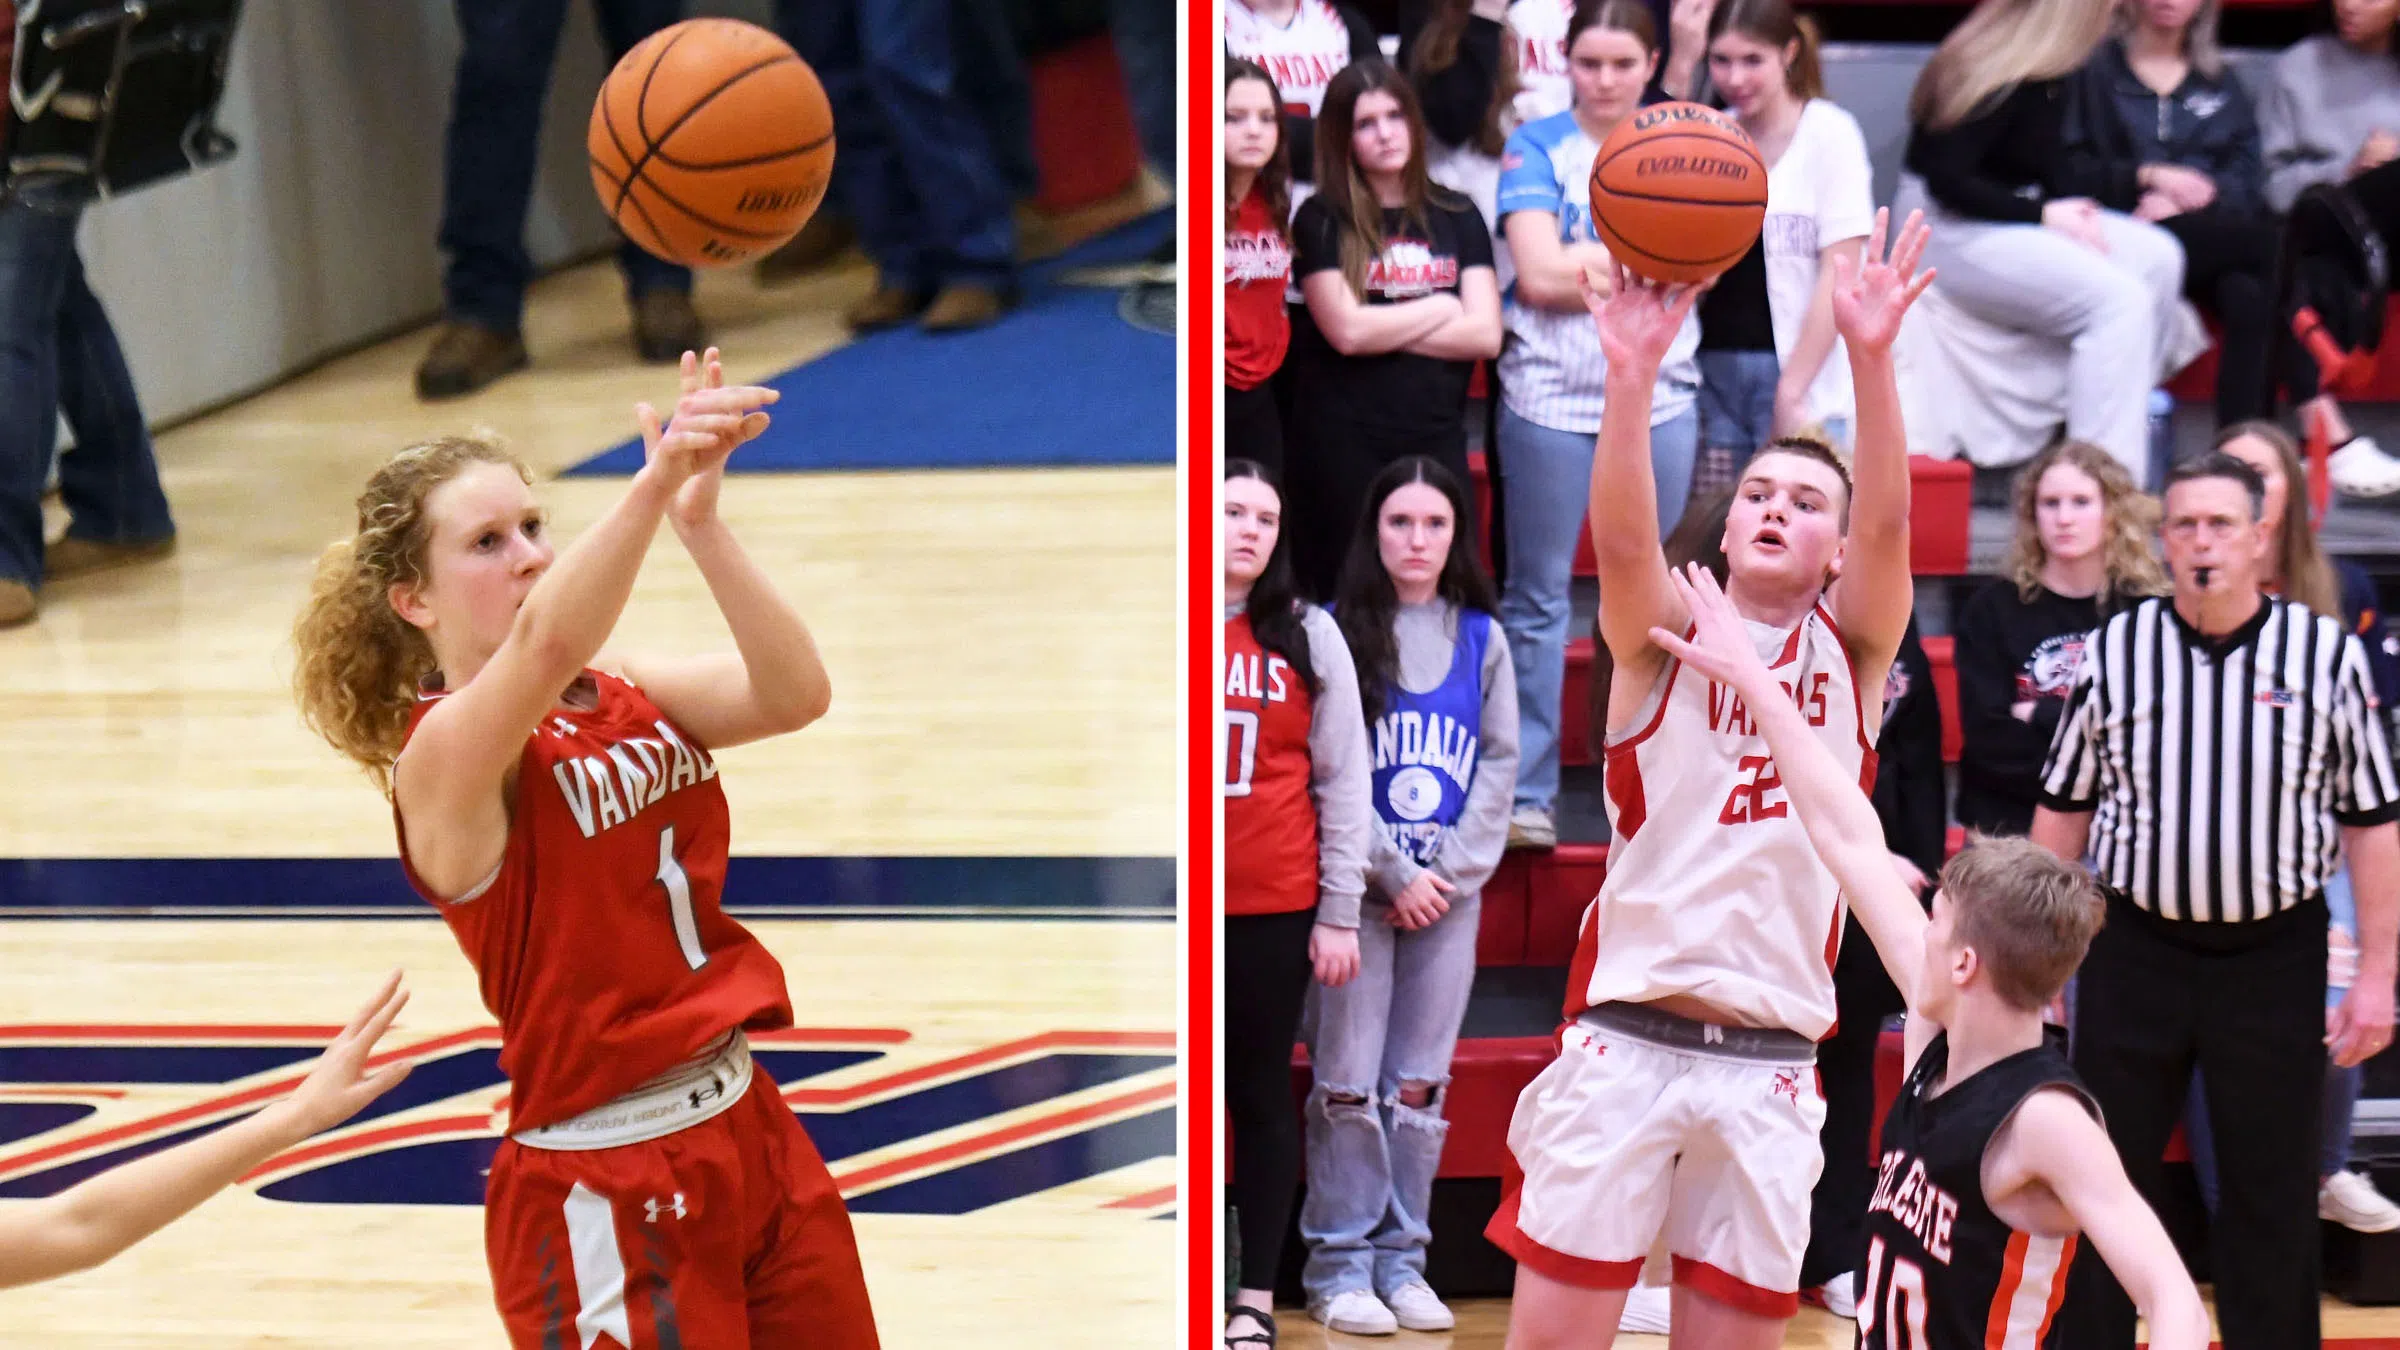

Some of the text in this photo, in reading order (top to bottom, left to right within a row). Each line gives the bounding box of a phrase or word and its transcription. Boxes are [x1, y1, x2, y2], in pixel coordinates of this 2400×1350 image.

[1636, 156, 1748, 181] EVOLUTION
[1365, 255, 1457, 289] ANDALS
[1718, 755, 1787, 826] 22
[655, 825, 709, 972] 1
